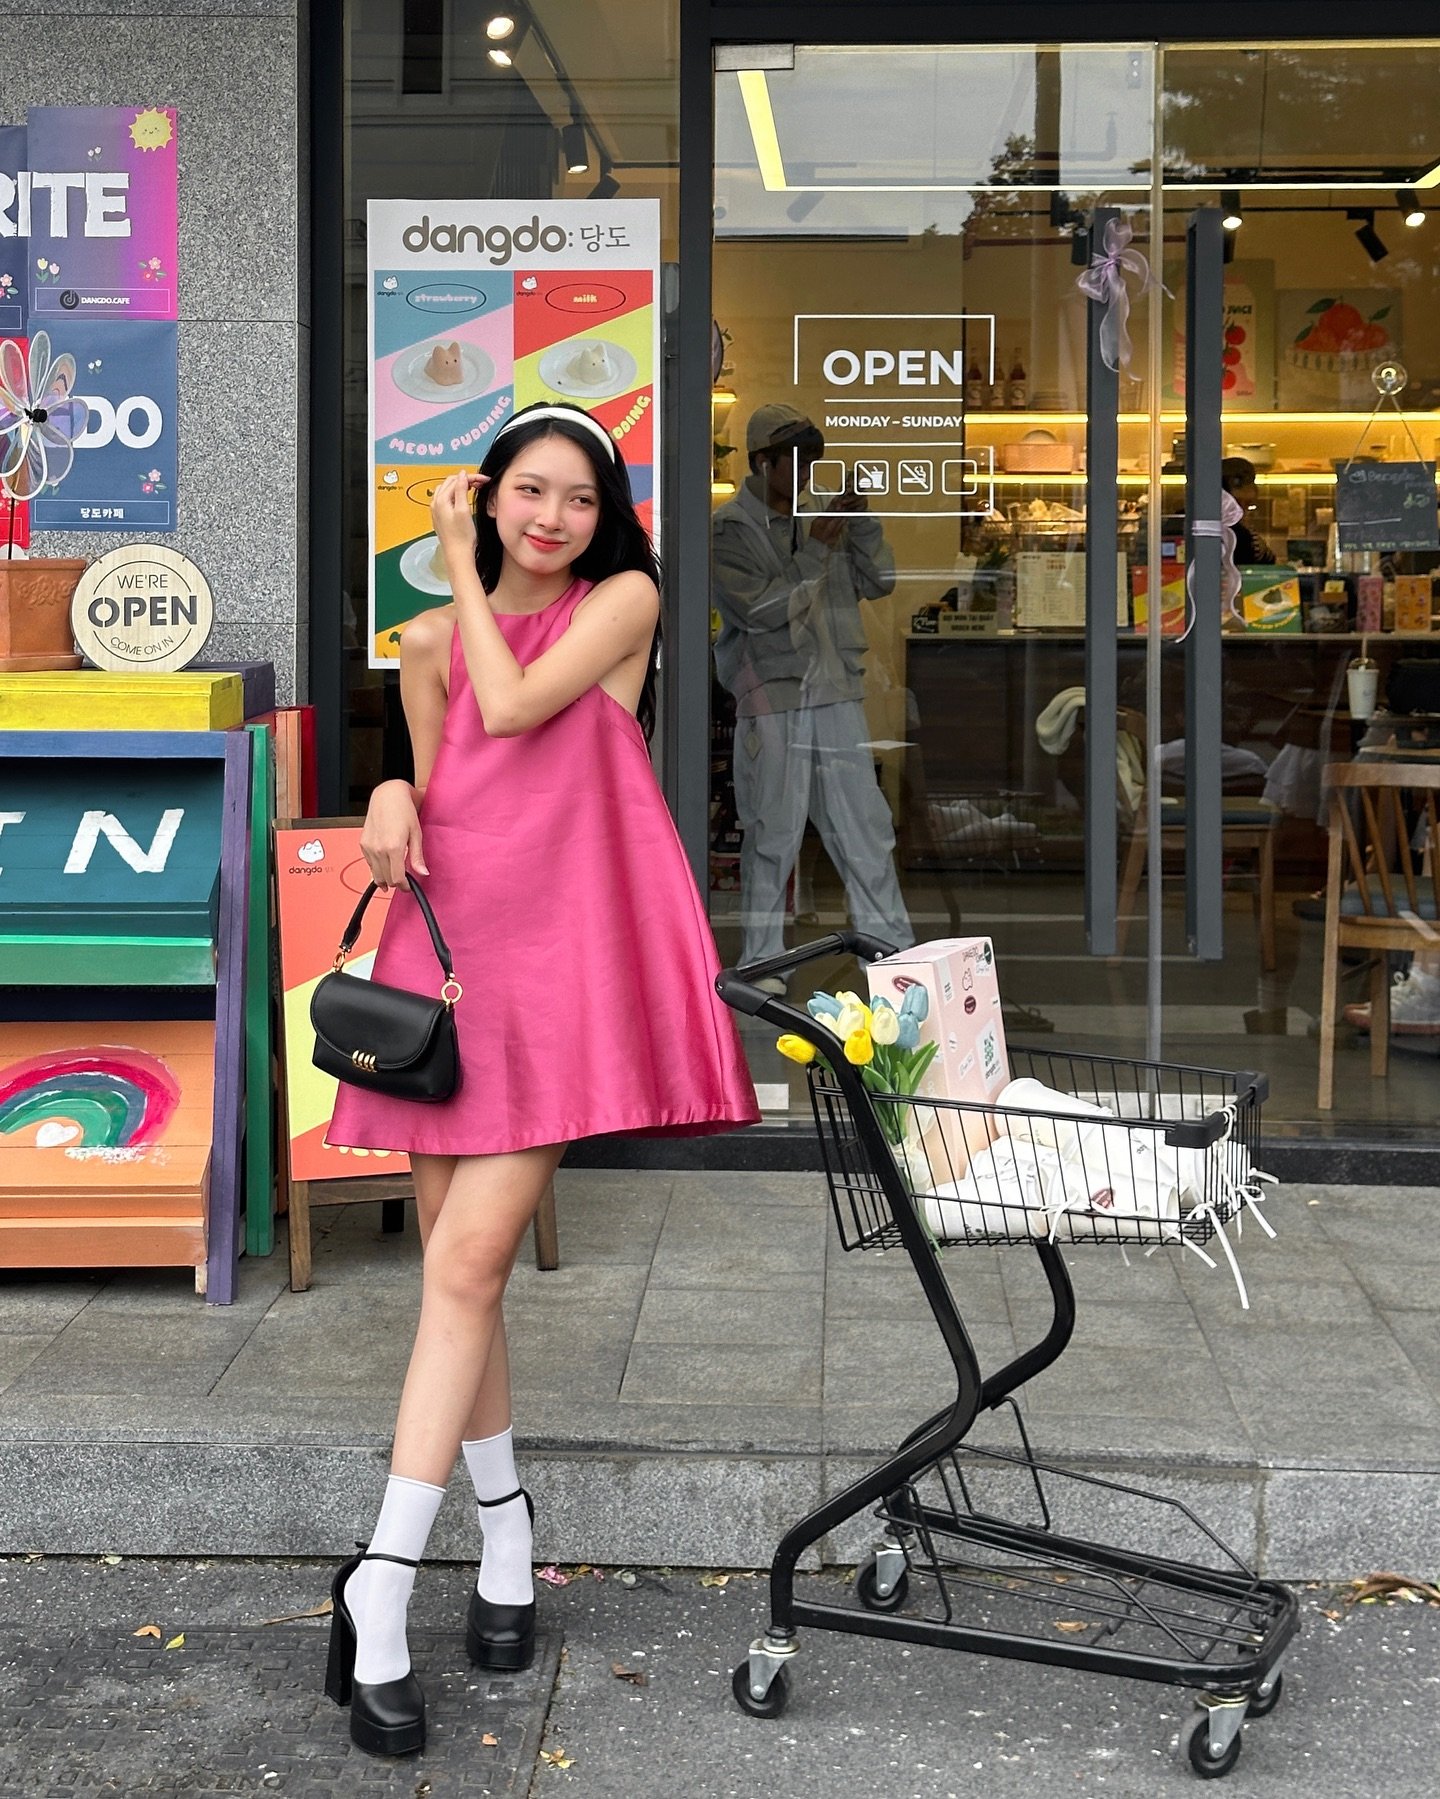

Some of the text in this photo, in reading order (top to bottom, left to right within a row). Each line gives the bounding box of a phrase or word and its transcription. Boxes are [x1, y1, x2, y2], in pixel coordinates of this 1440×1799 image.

[579, 224, 631, 253] 당도
[572, 293, 598, 303] milk
[822, 349, 963, 386] OPEN
[389, 395, 512, 456] MEOW PUDDING
[609, 395, 652, 440] DDING
[80, 507, 124, 519] 당도카페
[116, 574, 168, 589] WE'RE
[87, 595, 198, 628] OPEN
[110, 635, 174, 656] COME ON IN
[288, 866, 323, 876] dangdo
